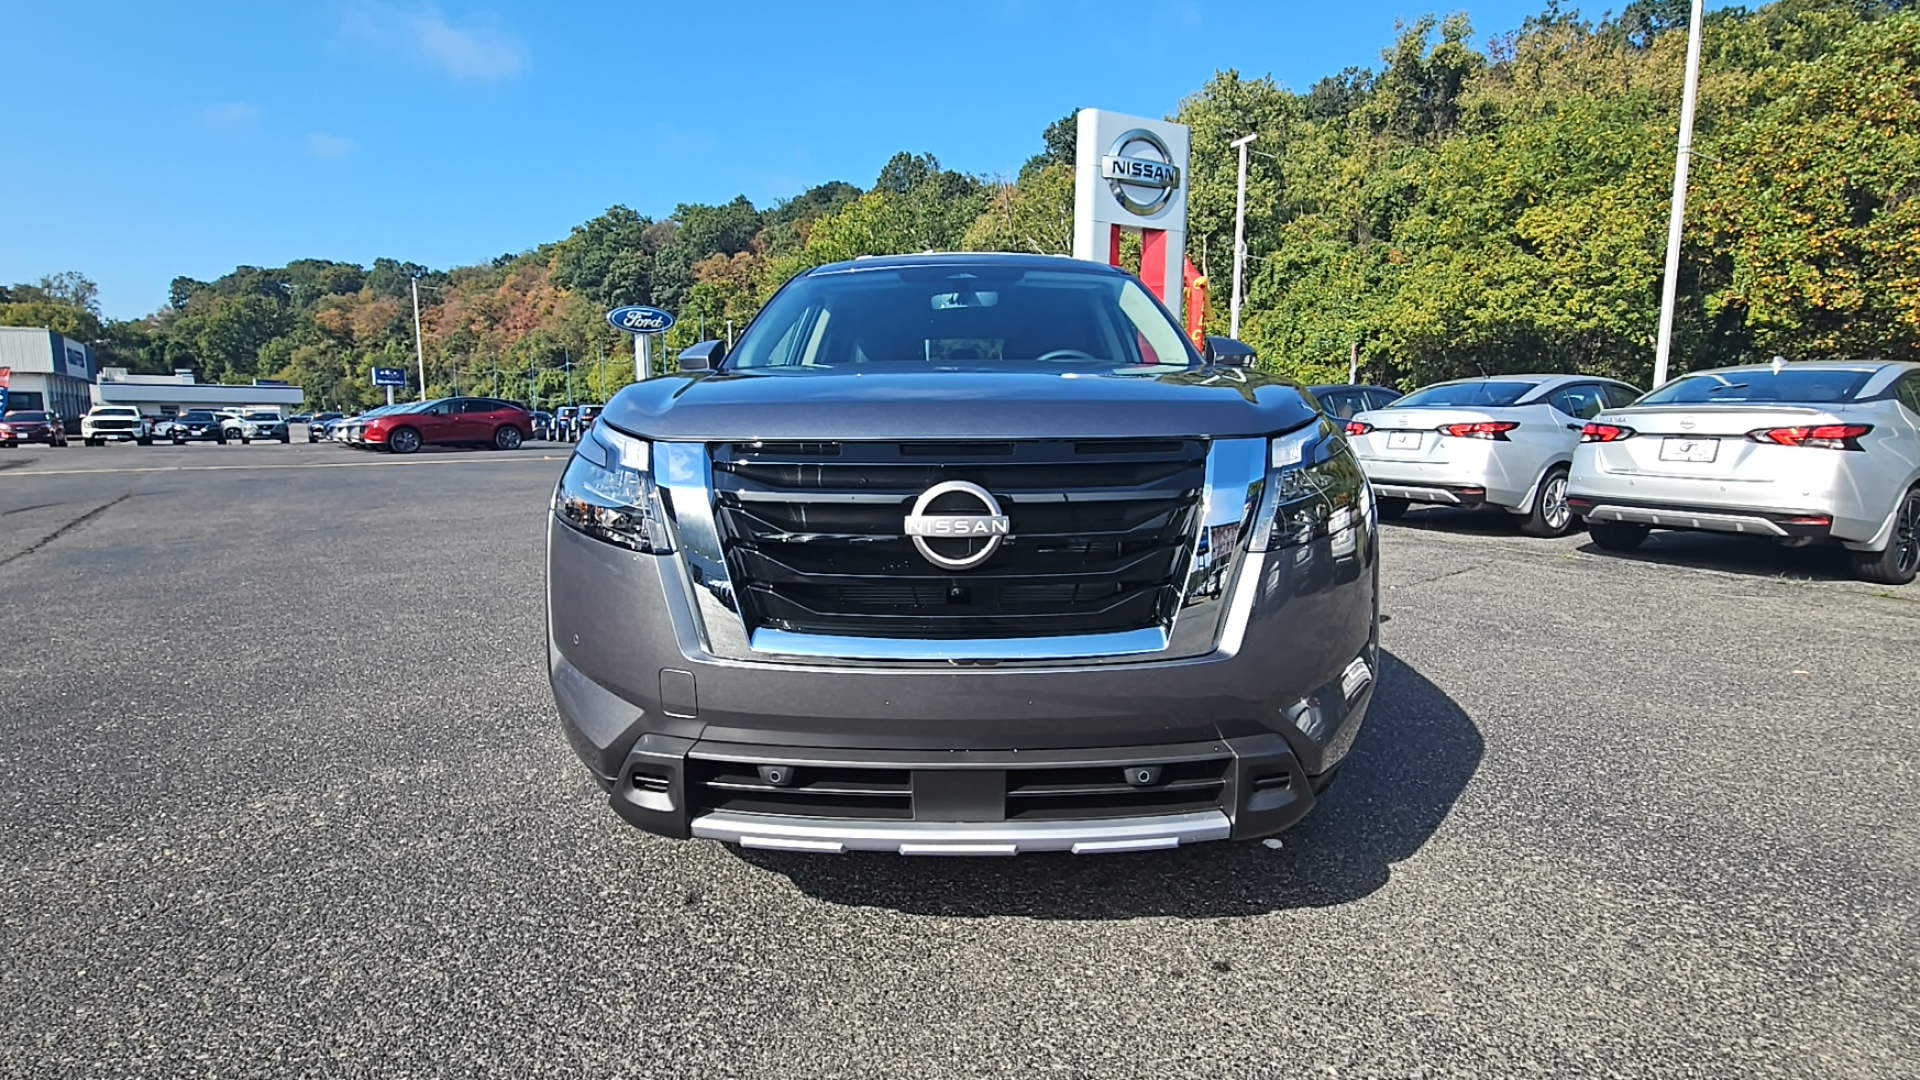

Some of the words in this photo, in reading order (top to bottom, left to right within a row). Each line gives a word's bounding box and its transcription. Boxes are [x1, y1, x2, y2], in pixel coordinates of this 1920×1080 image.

[1112, 160, 1174, 181] NISSAN
[623, 310, 663, 328] Ford
[907, 519, 1007, 534] NISSAN
